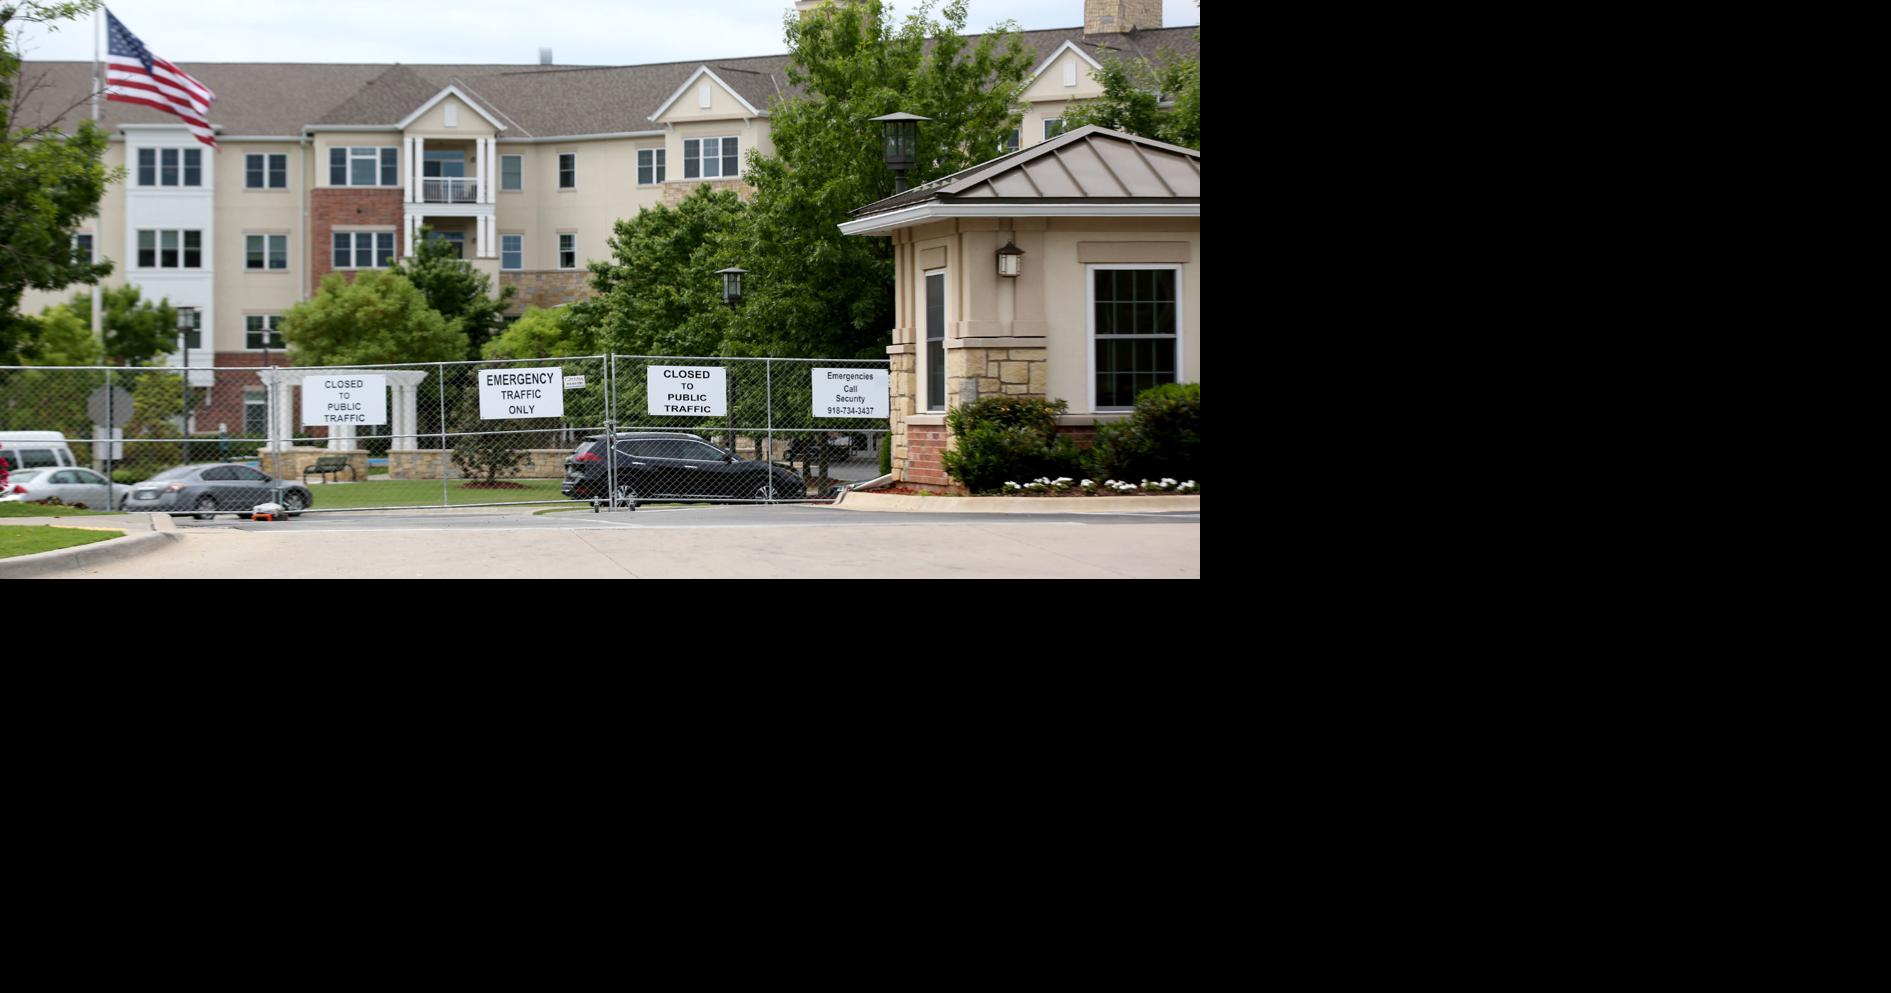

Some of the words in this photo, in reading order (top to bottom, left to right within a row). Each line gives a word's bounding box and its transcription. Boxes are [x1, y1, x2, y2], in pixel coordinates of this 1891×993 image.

[664, 370, 710, 378] CLOSED
[827, 372, 874, 381] Emergencies
[487, 372, 554, 386] EMERGENCY
[324, 380, 364, 388] CLOSED
[501, 389, 542, 400] TRAFFIC
[668, 394, 707, 402] PUBLIC
[836, 394, 865, 404] Security
[328, 402, 361, 410] PUBLIC
[508, 405, 534, 414] ONLY
[664, 405, 711, 413] TRAFFIC
[828, 406, 874, 414] 918-734-3437
[324, 414, 366, 422] TRAFFIC
